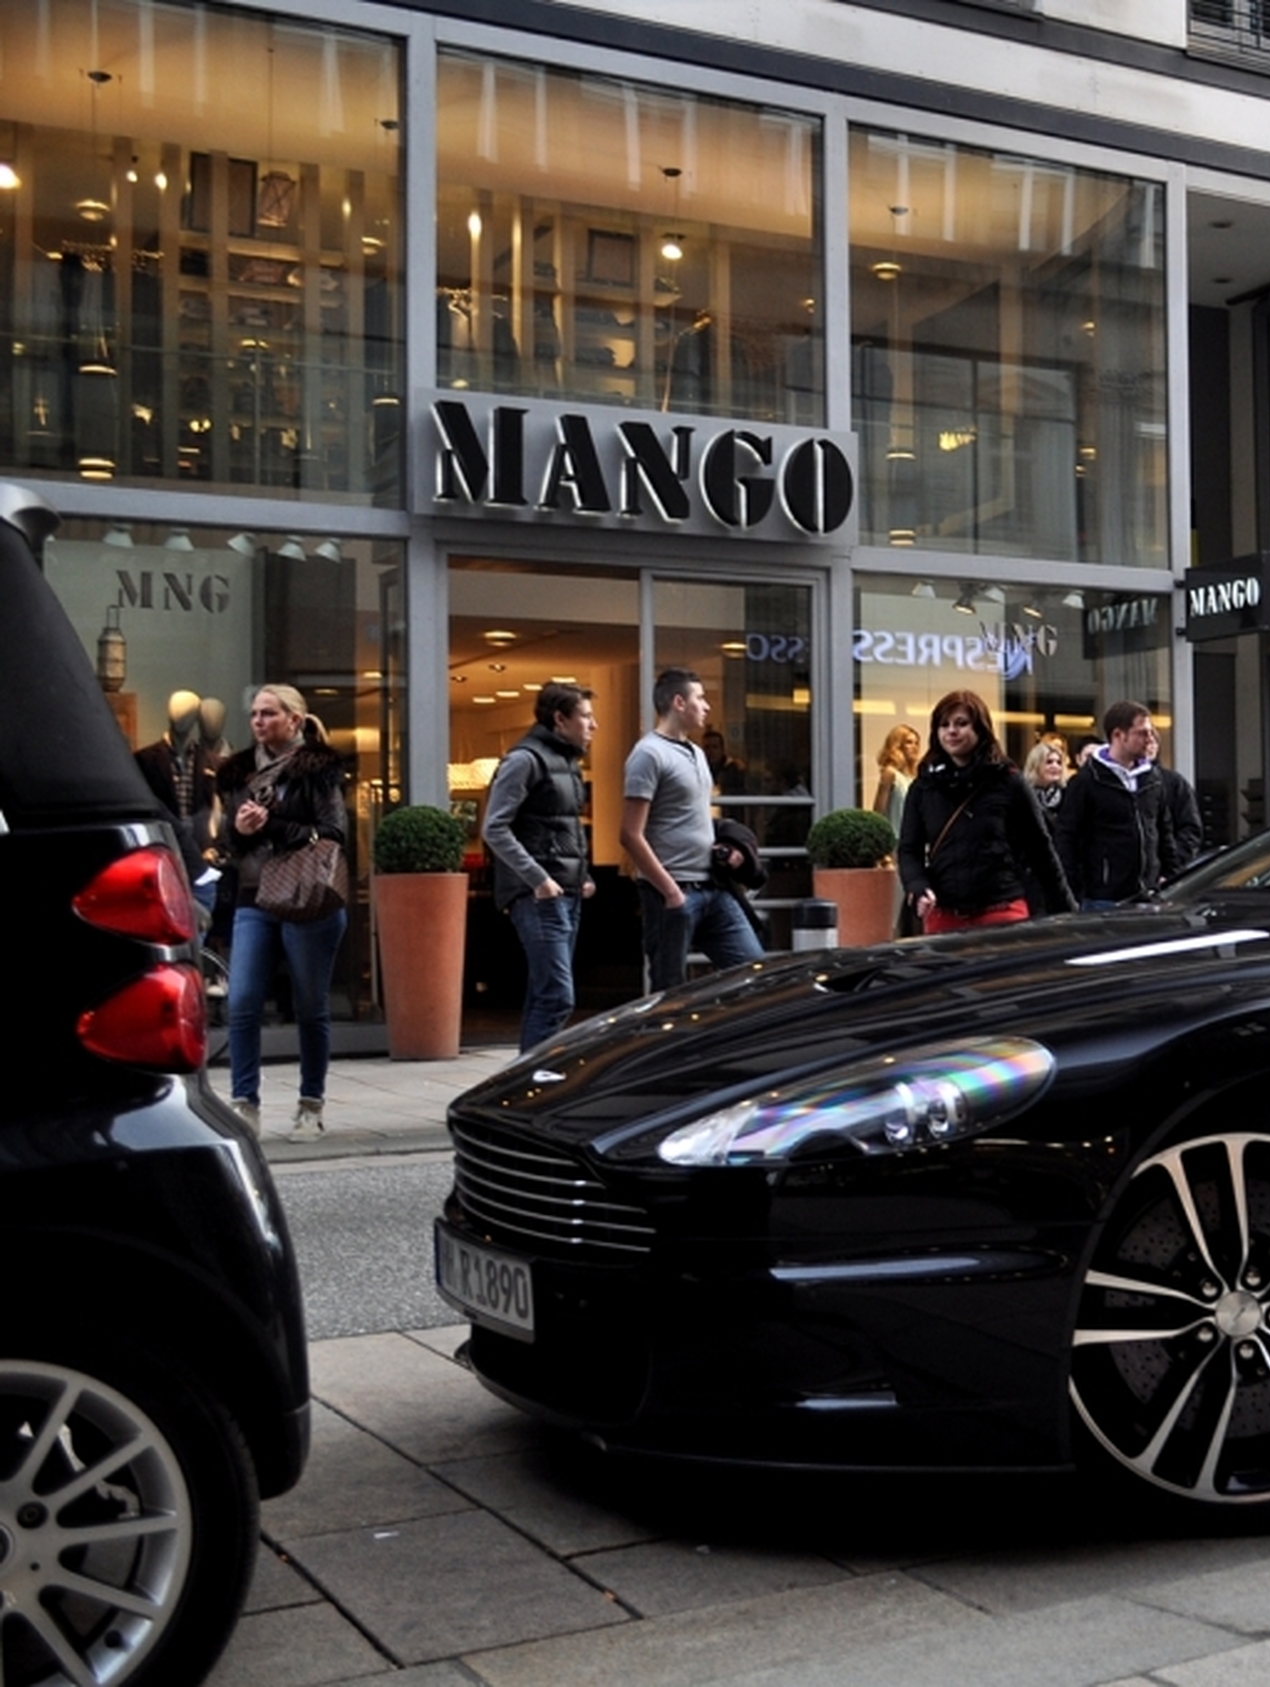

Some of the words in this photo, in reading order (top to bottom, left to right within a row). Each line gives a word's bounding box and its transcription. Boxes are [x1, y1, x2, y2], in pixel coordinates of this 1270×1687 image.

[431, 400, 854, 535] MANGO
[116, 569, 230, 613] MNG
[1190, 577, 1260, 617] MANGO
